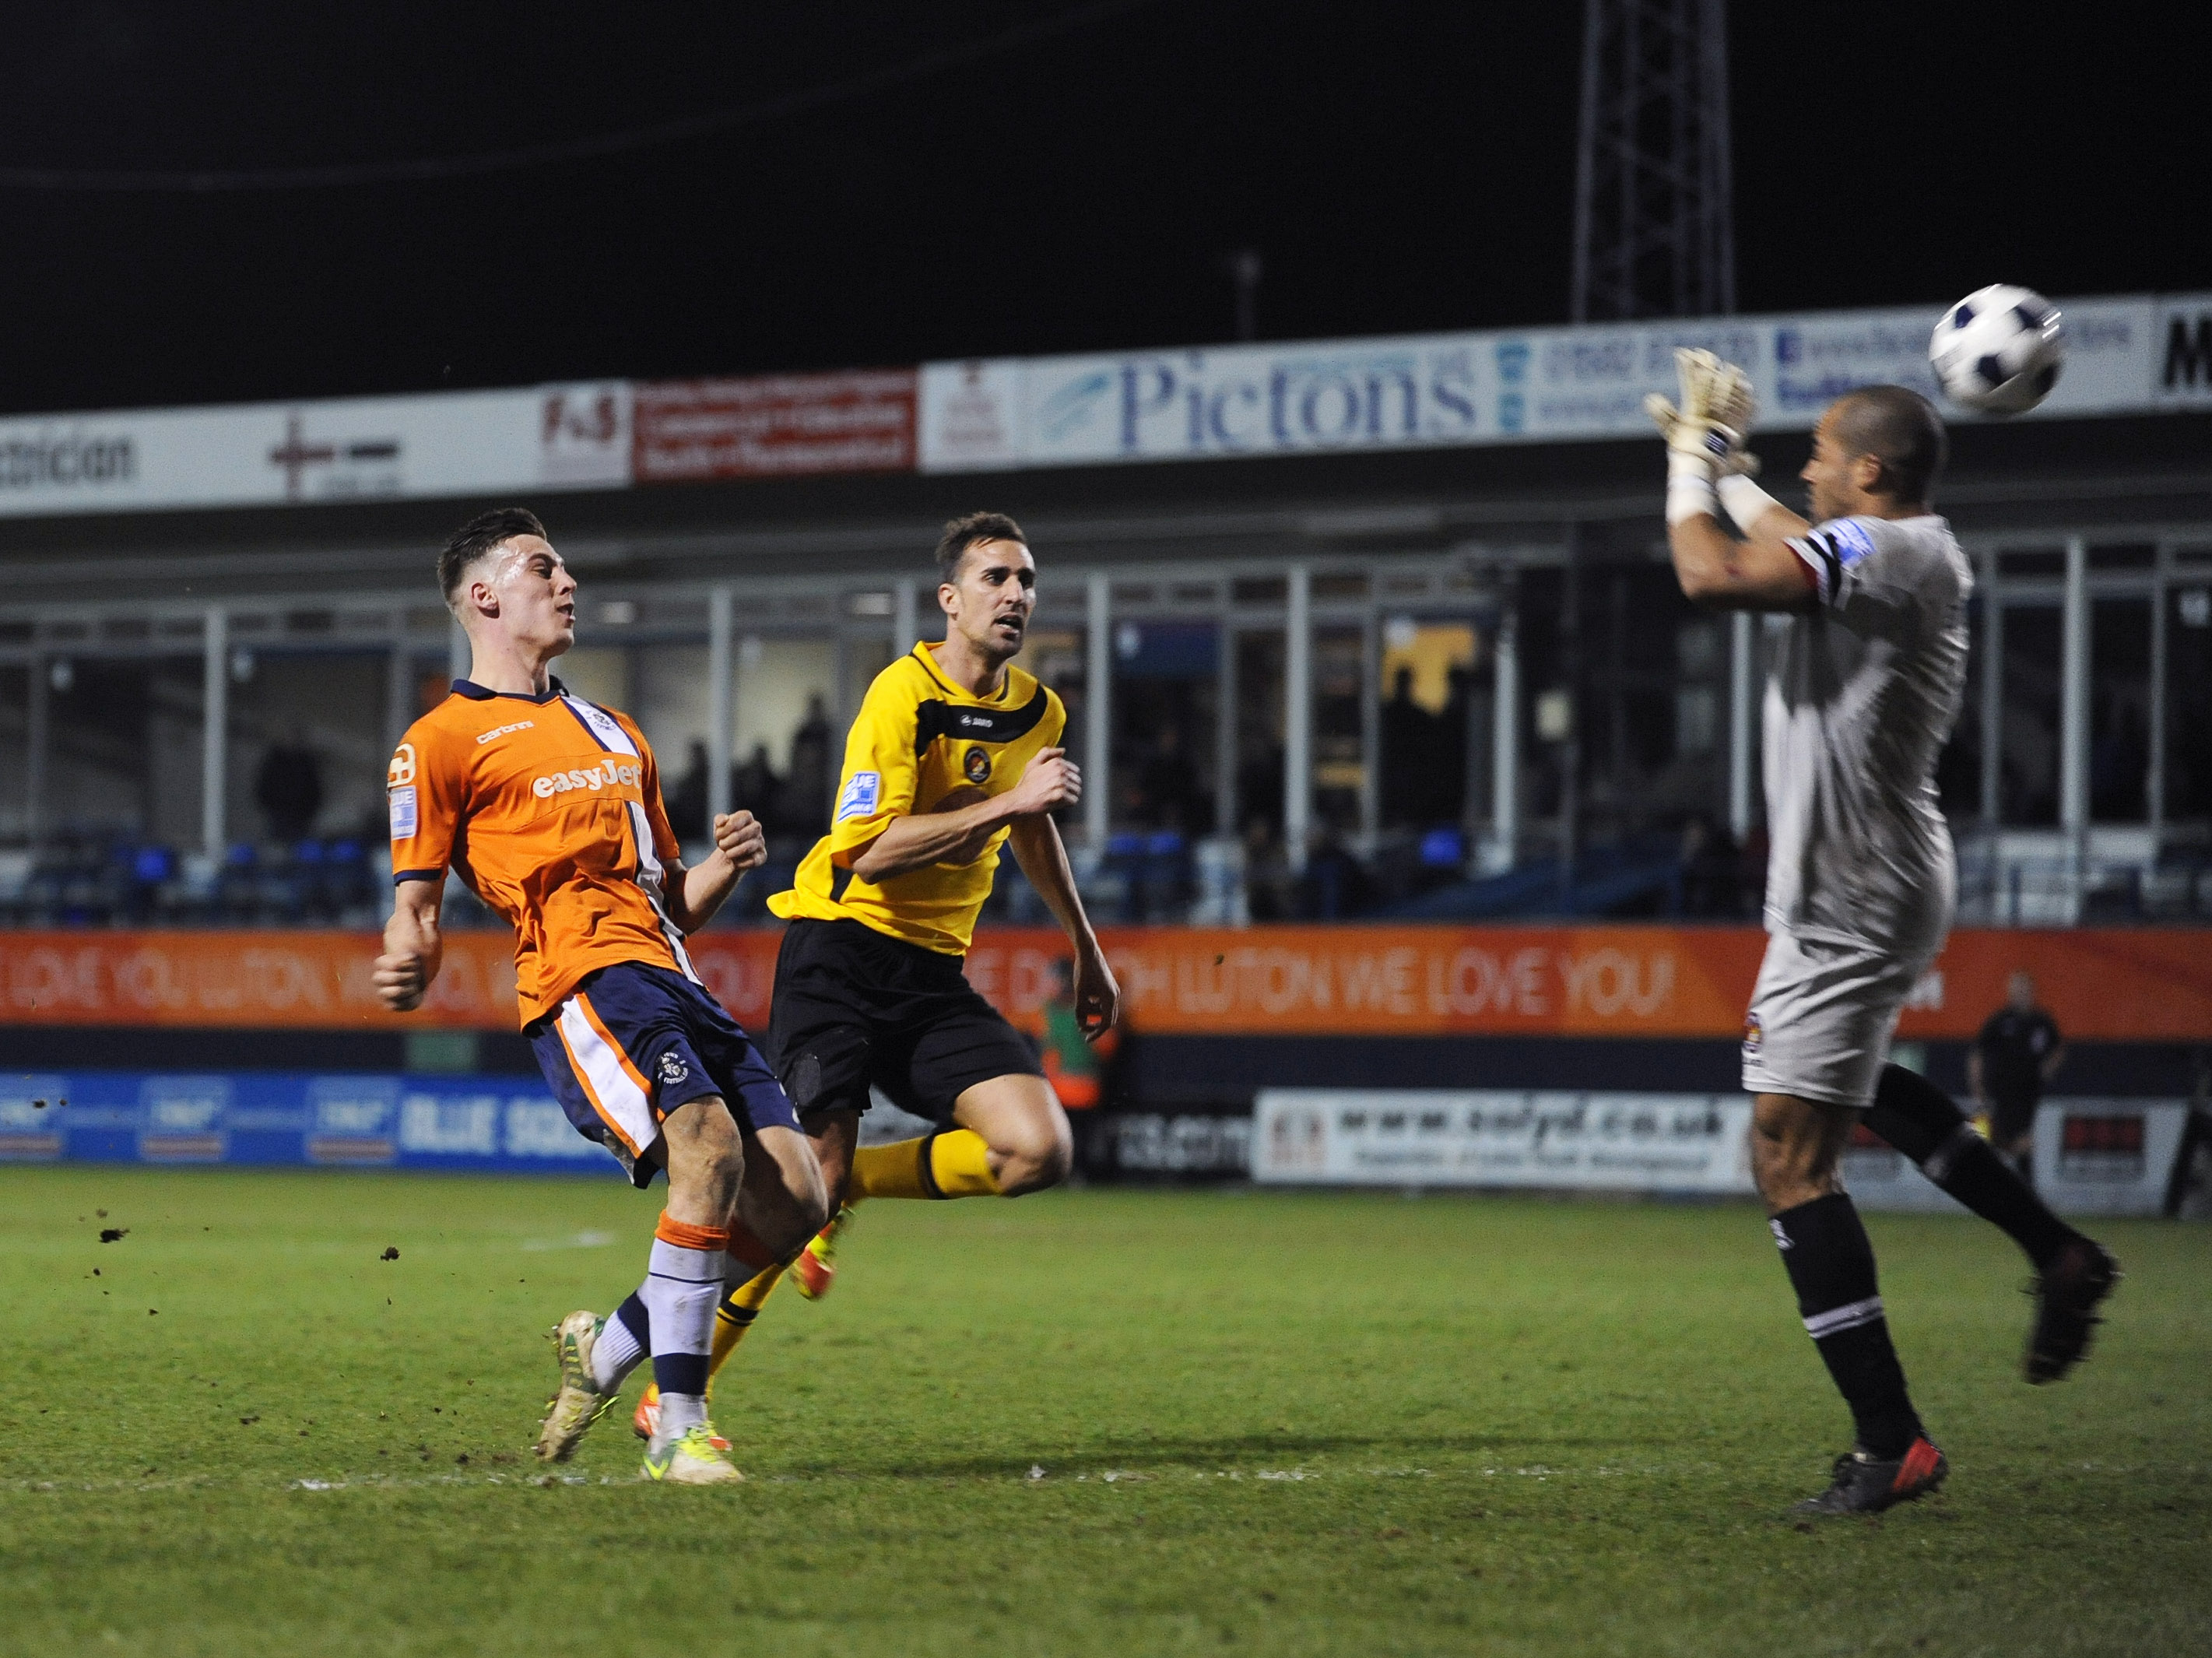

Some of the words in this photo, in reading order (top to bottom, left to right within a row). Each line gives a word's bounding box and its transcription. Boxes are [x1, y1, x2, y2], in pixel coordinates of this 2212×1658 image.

[1118, 348, 1476, 450] Pictons
[533, 759, 641, 799] easyJet
[1176, 947, 1332, 1013] LUTON
[1340, 947, 1419, 1013] WE
[1426, 947, 1551, 1013] LOVE
